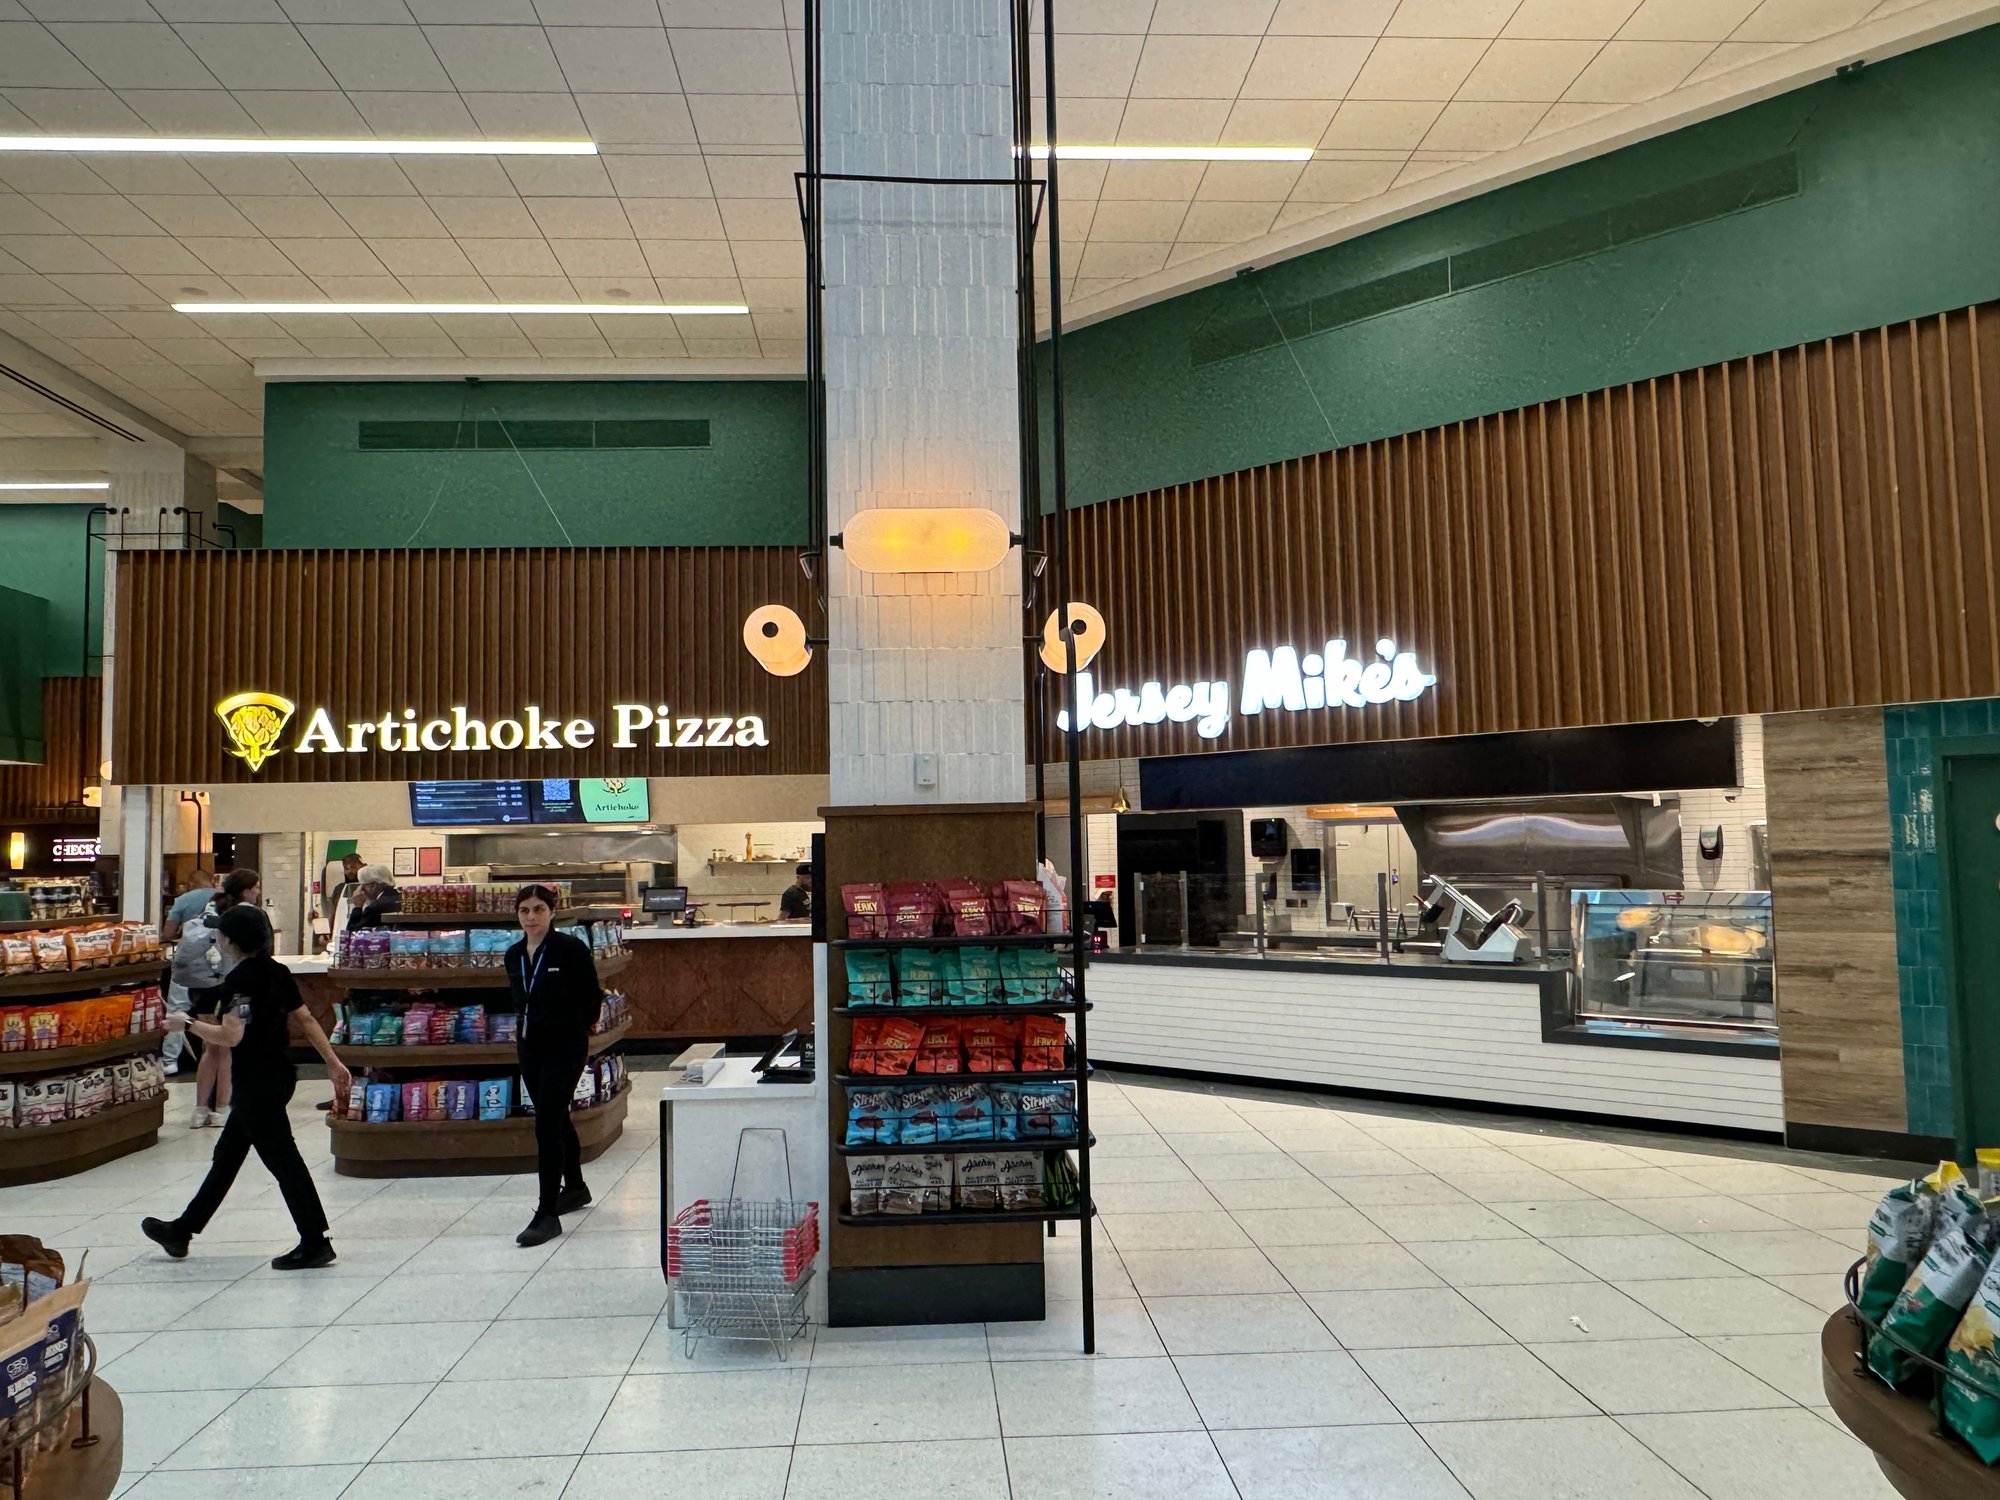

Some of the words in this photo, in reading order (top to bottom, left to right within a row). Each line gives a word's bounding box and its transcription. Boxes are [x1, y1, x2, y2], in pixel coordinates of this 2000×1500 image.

[1057, 672, 1230, 738] Jersey
[1240, 638, 1437, 715] Mike's
[295, 706, 595, 754] Artichoke
[611, 704, 770, 749] Pizza
